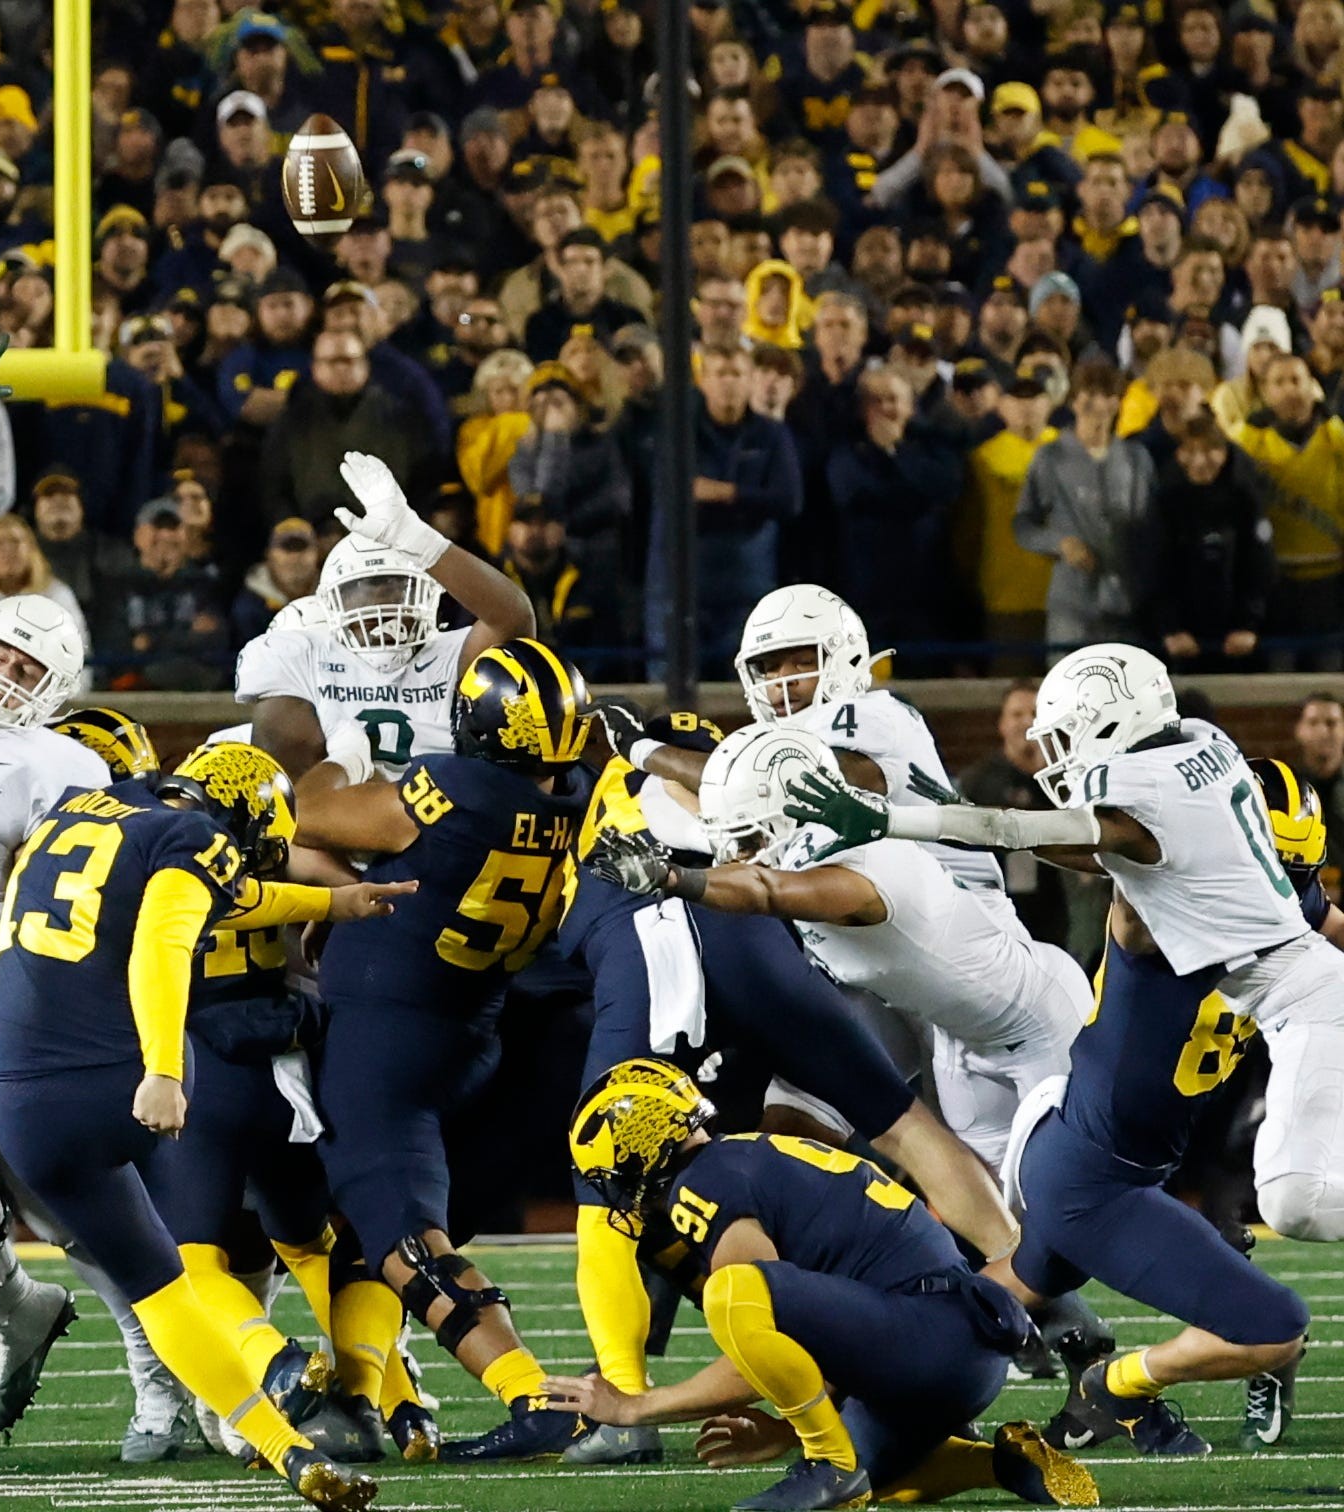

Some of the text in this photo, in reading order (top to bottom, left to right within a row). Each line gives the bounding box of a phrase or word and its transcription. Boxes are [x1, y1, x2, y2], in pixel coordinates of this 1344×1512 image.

[318, 680, 448, 704] MICHIGAN STATE
[831, 703, 858, 738] 4
[58, 790, 152, 820] MOODY
[402, 765, 455, 825] 58
[194, 833, 241, 886] 13
[670, 1186, 719, 1243] 91
[528, 1397, 548, 1412] M
